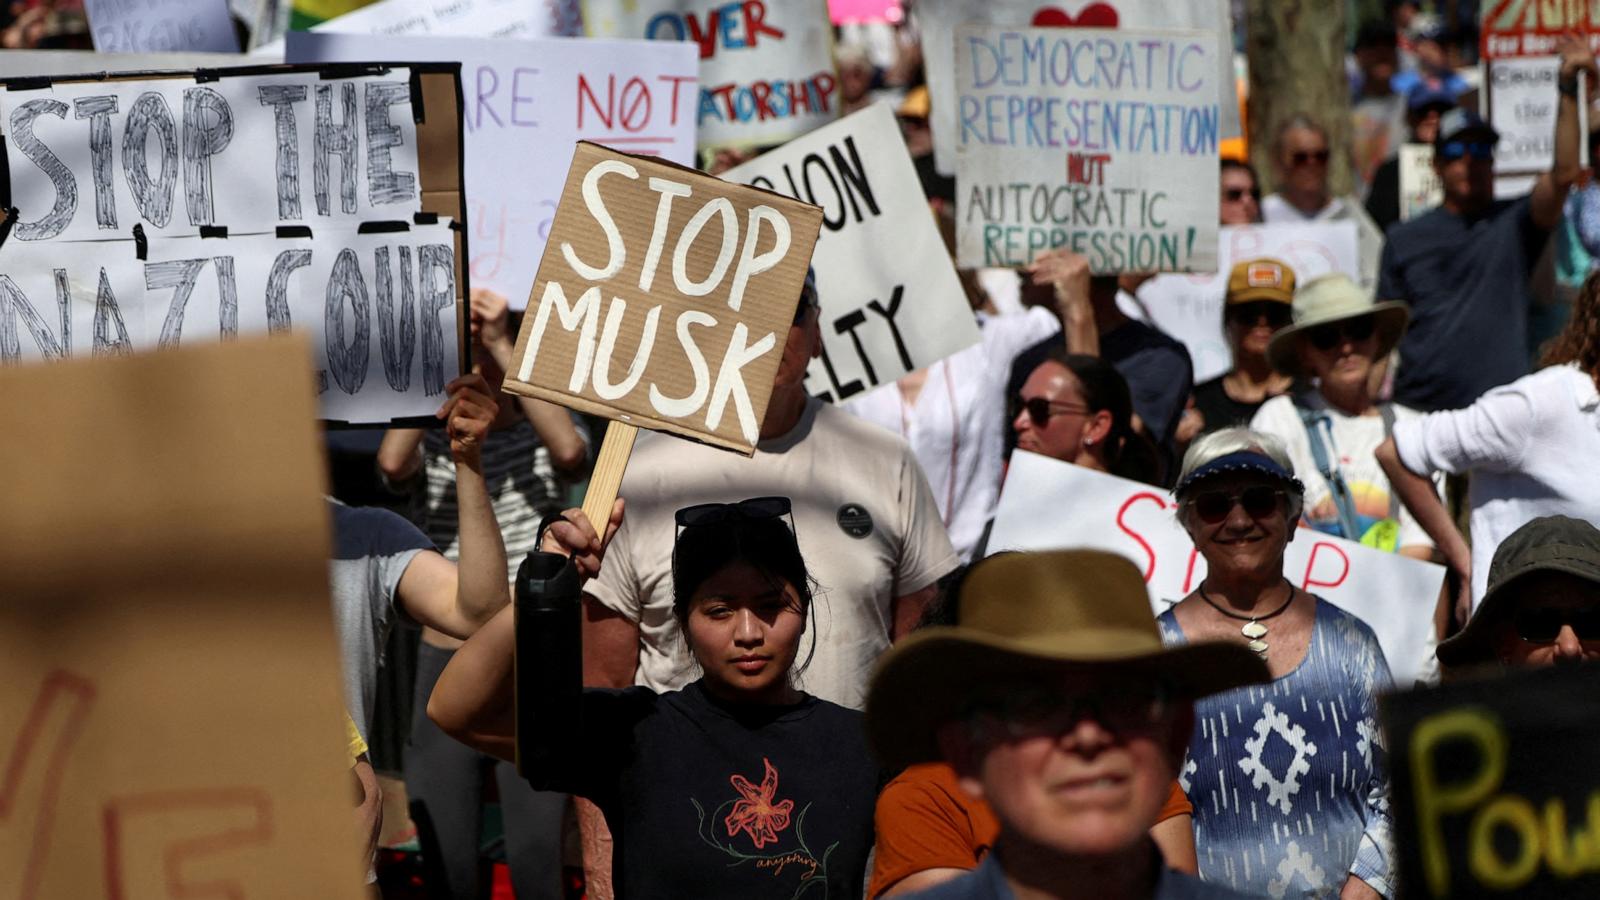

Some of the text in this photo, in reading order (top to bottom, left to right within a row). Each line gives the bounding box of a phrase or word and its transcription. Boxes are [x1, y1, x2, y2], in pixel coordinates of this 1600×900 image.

[645, 0, 785, 59] OVER
[967, 32, 1205, 92] DEMOCRATIC
[463, 65, 540, 133] RE
[697, 71, 836, 123] ATORSHIP
[958, 95, 1219, 154] REPRESENTATION
[9, 81, 415, 241] STOP THE
[752, 135, 881, 232] ION
[1066, 152, 1112, 186] NOT
[559, 159, 793, 313] STOP
[966, 182, 1168, 229] AUTOCRATIC
[984, 222, 1197, 273] REPRESSION!
[0, 244, 456, 396] NAZI COUP
[517, 281, 777, 446] MUSK
[1116, 491, 1350, 594] SP
[1411, 706, 1600, 898] Pow
